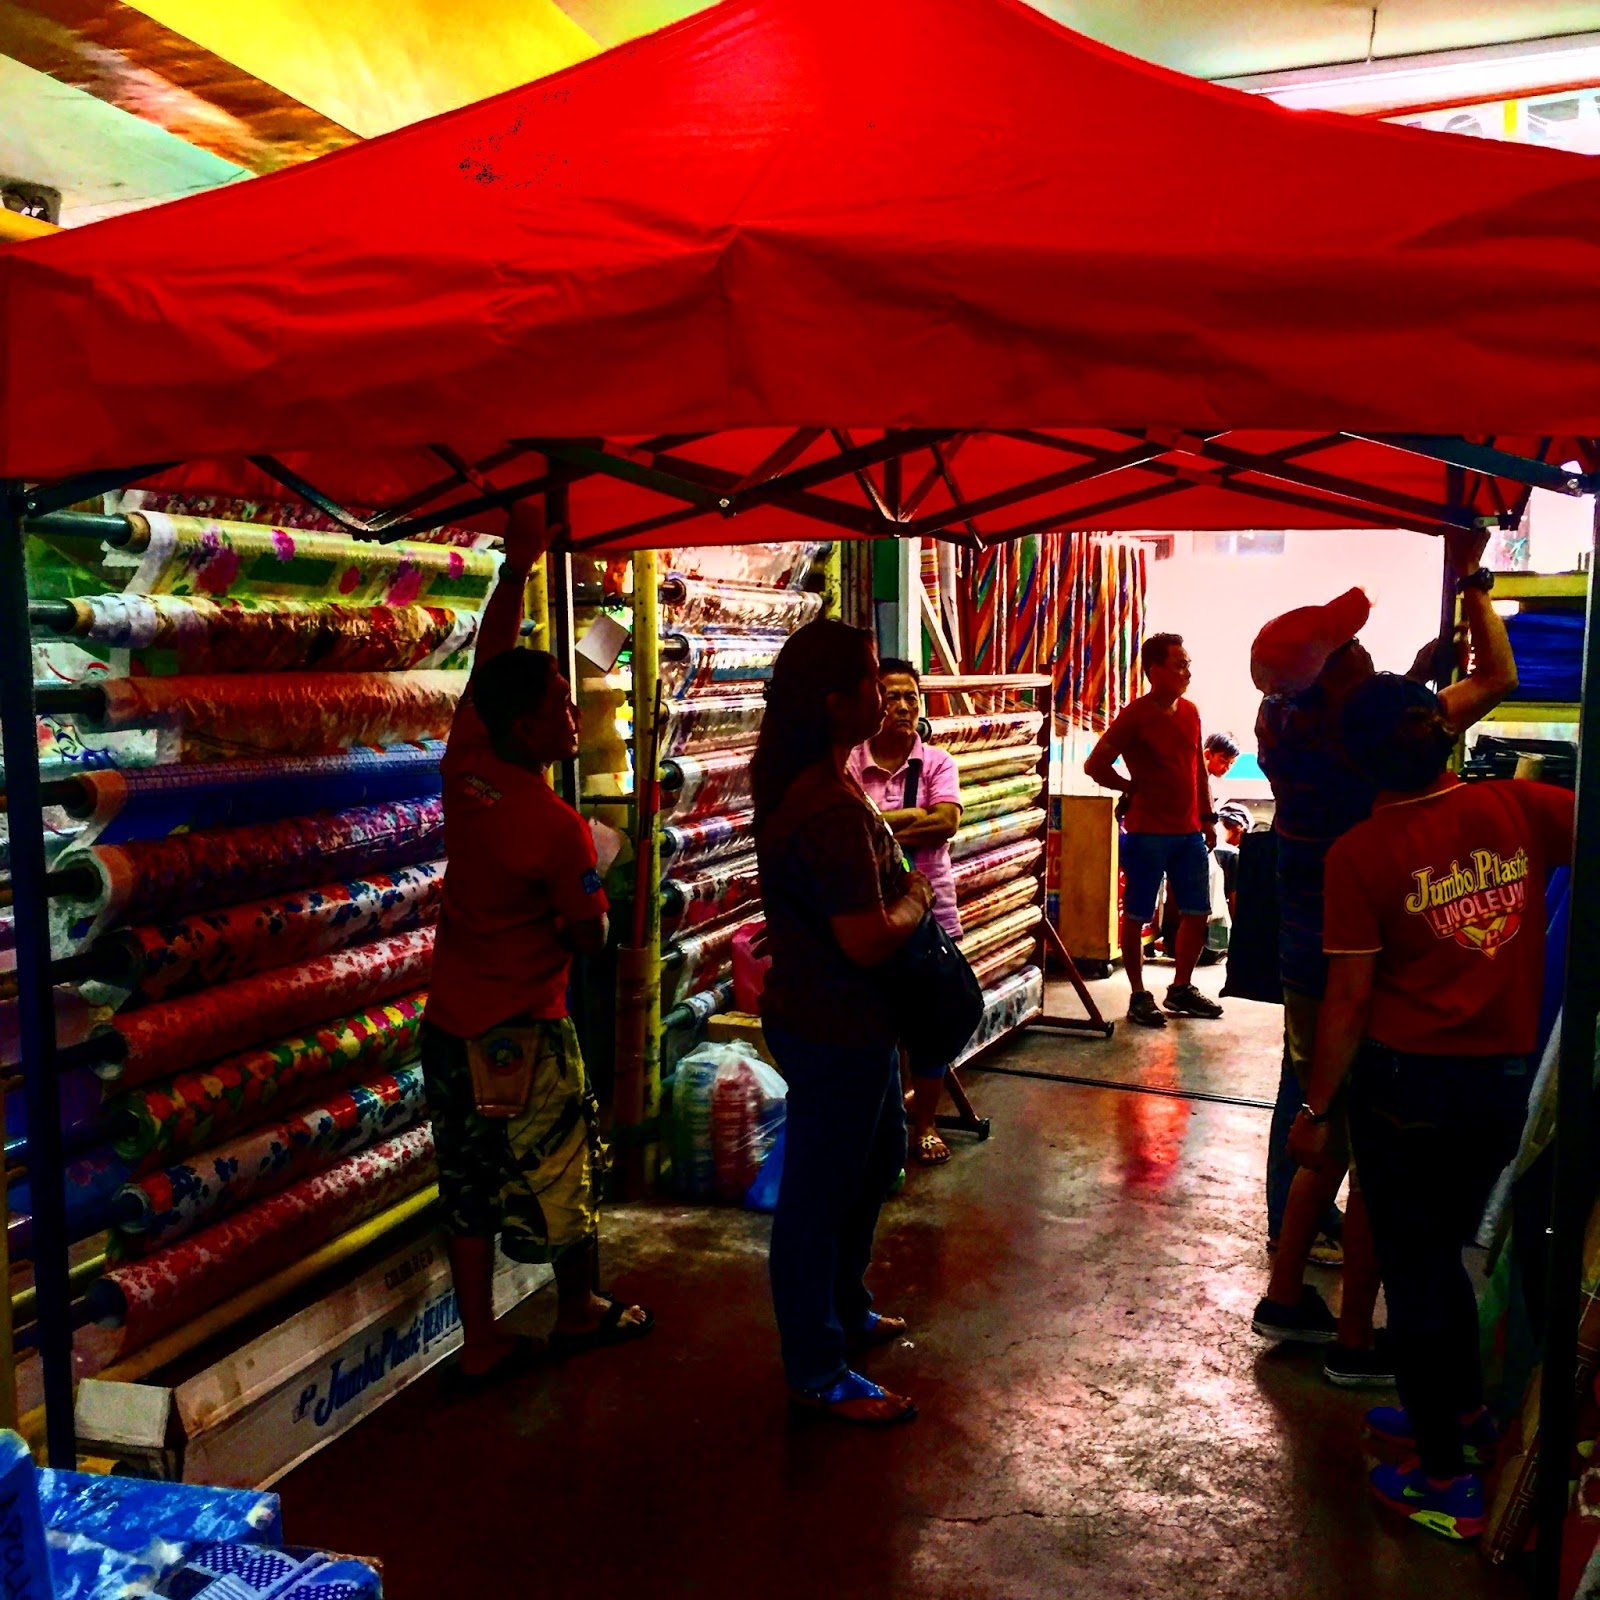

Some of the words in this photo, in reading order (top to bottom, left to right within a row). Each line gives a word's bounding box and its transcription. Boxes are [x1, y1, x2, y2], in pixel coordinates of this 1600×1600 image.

[1405, 861, 1474, 913] Jumbo
[1472, 848, 1528, 890] Plastic
[1431, 881, 1524, 930] LINOLEUM
[314, 1344, 384, 1427] Jumbo
